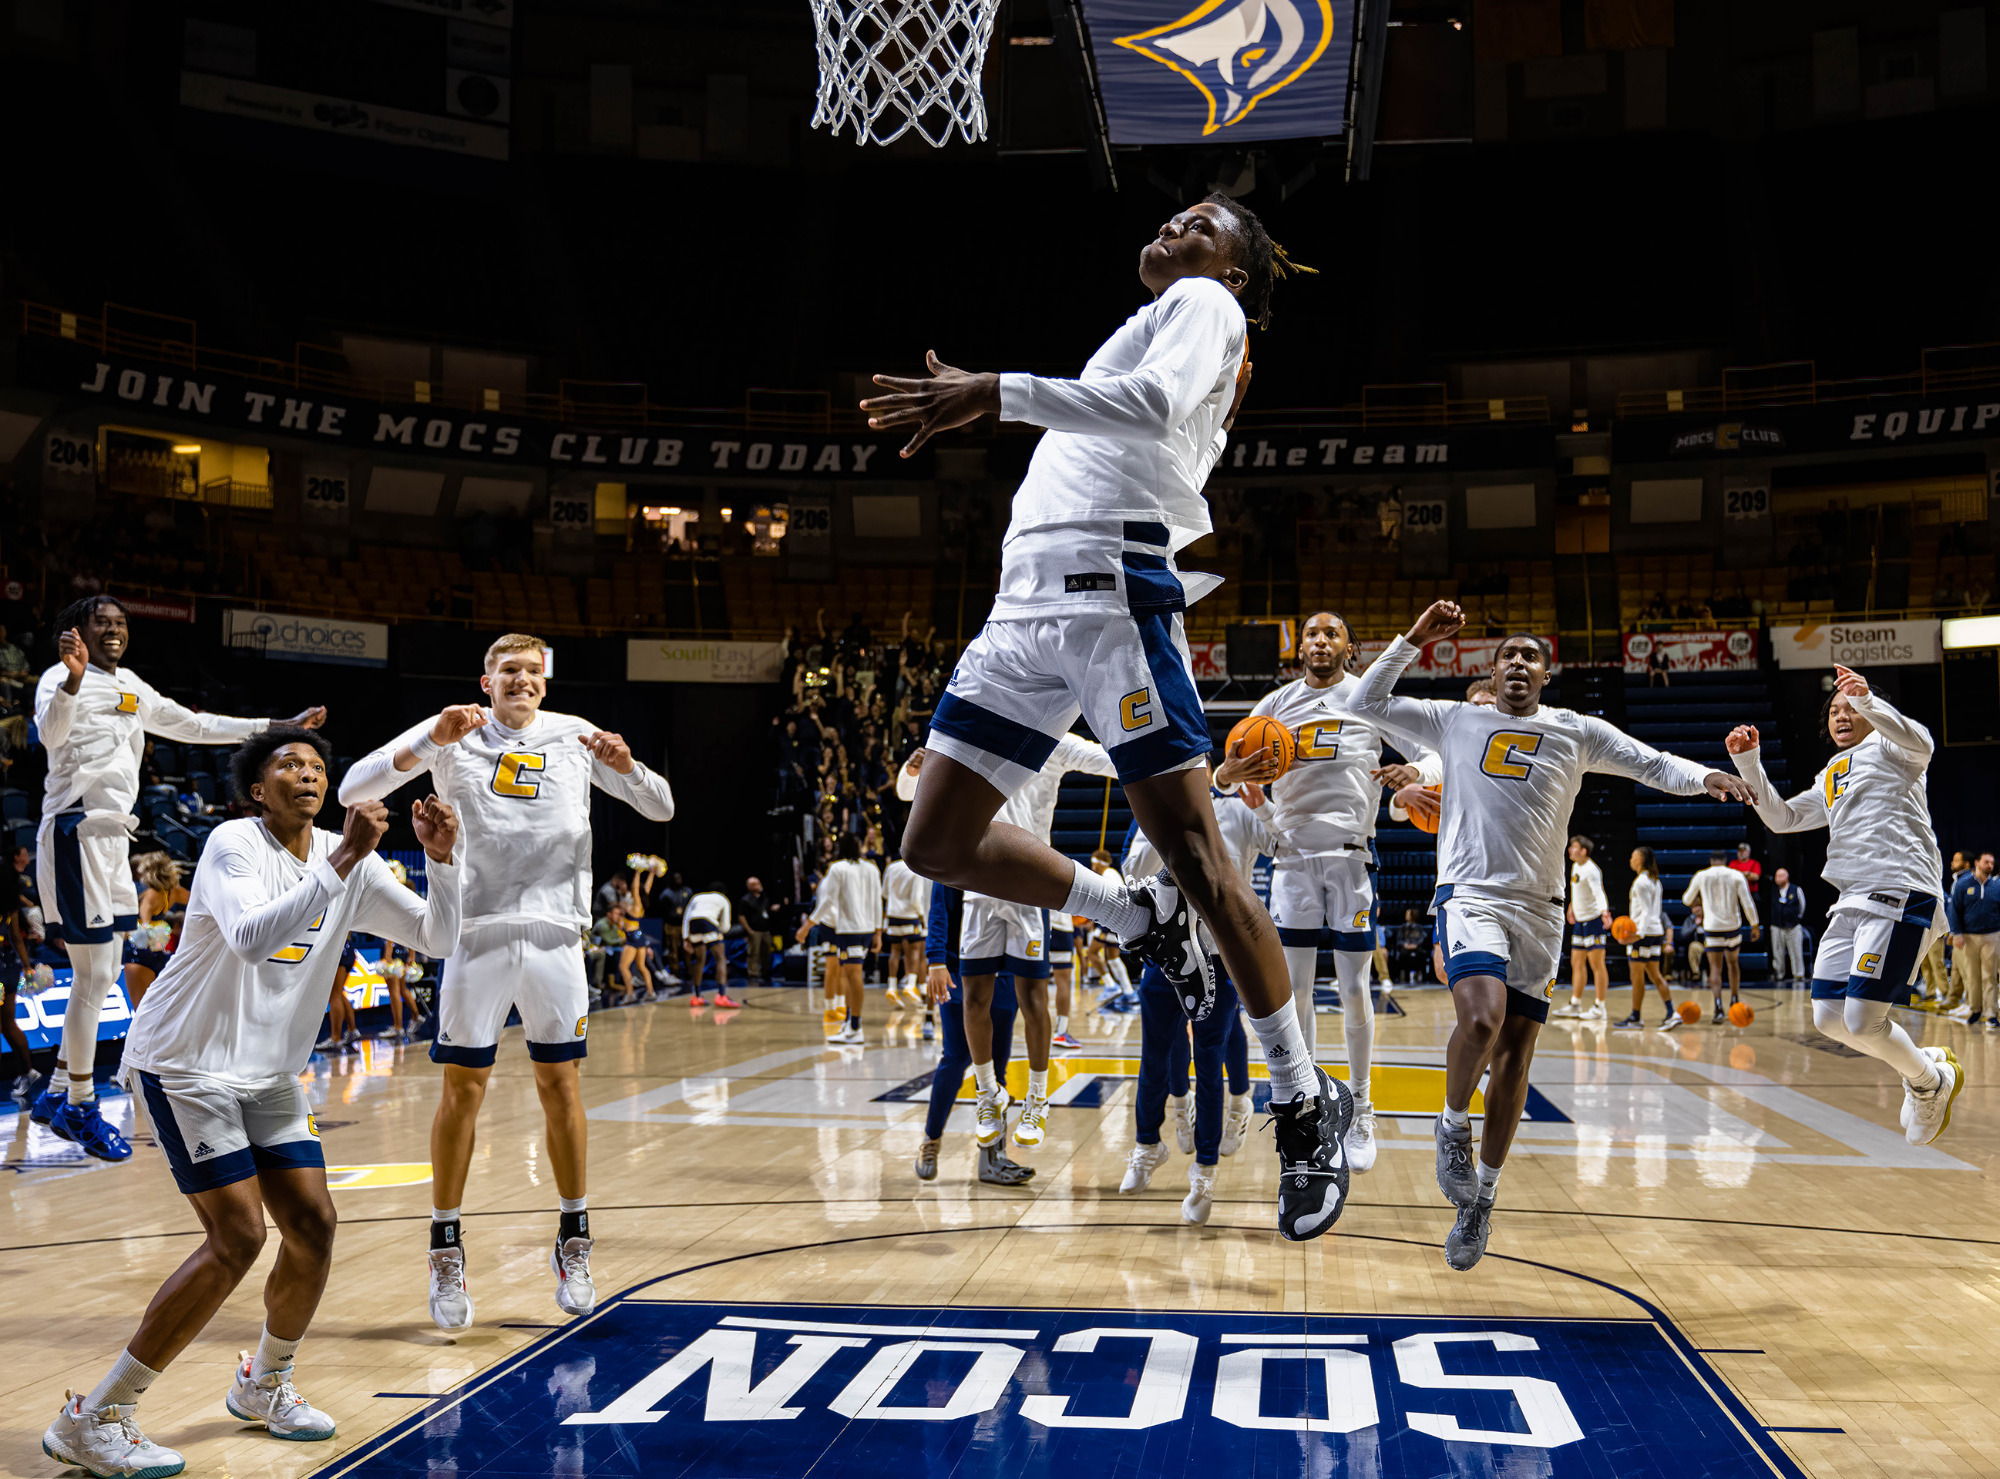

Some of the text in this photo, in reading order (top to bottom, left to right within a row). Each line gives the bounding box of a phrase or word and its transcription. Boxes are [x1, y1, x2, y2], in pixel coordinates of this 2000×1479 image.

[80, 362, 879, 473] JOIN THE MOCS CLUB TODAY
[1742, 429, 1781, 443] CLUB
[50, 438, 90, 468] 204
[1217, 438, 1449, 468] theTeam
[307, 477, 346, 503] 205
[1727, 490, 1767, 514] 209
[552, 501, 589, 524] 205
[793, 508, 830, 531] 206
[1406, 503, 1443, 526] 208
[280, 620, 366, 650] choices
[1830, 627, 1896, 645] Steam
[660, 643, 755, 663] SouthEast
[1830, 643, 1914, 667] Logistics
[1119, 686, 1153, 733] C
[1294, 720, 1344, 762] C
[1480, 729, 1545, 782] C
[490, 751, 547, 800] C
[1825, 754, 1853, 811] C
[1353, 909, 1371, 928] C
[1025, 940, 1042, 957] C
[1857, 952, 1882, 974] C
[194, 1147, 216, 1158] adidas
